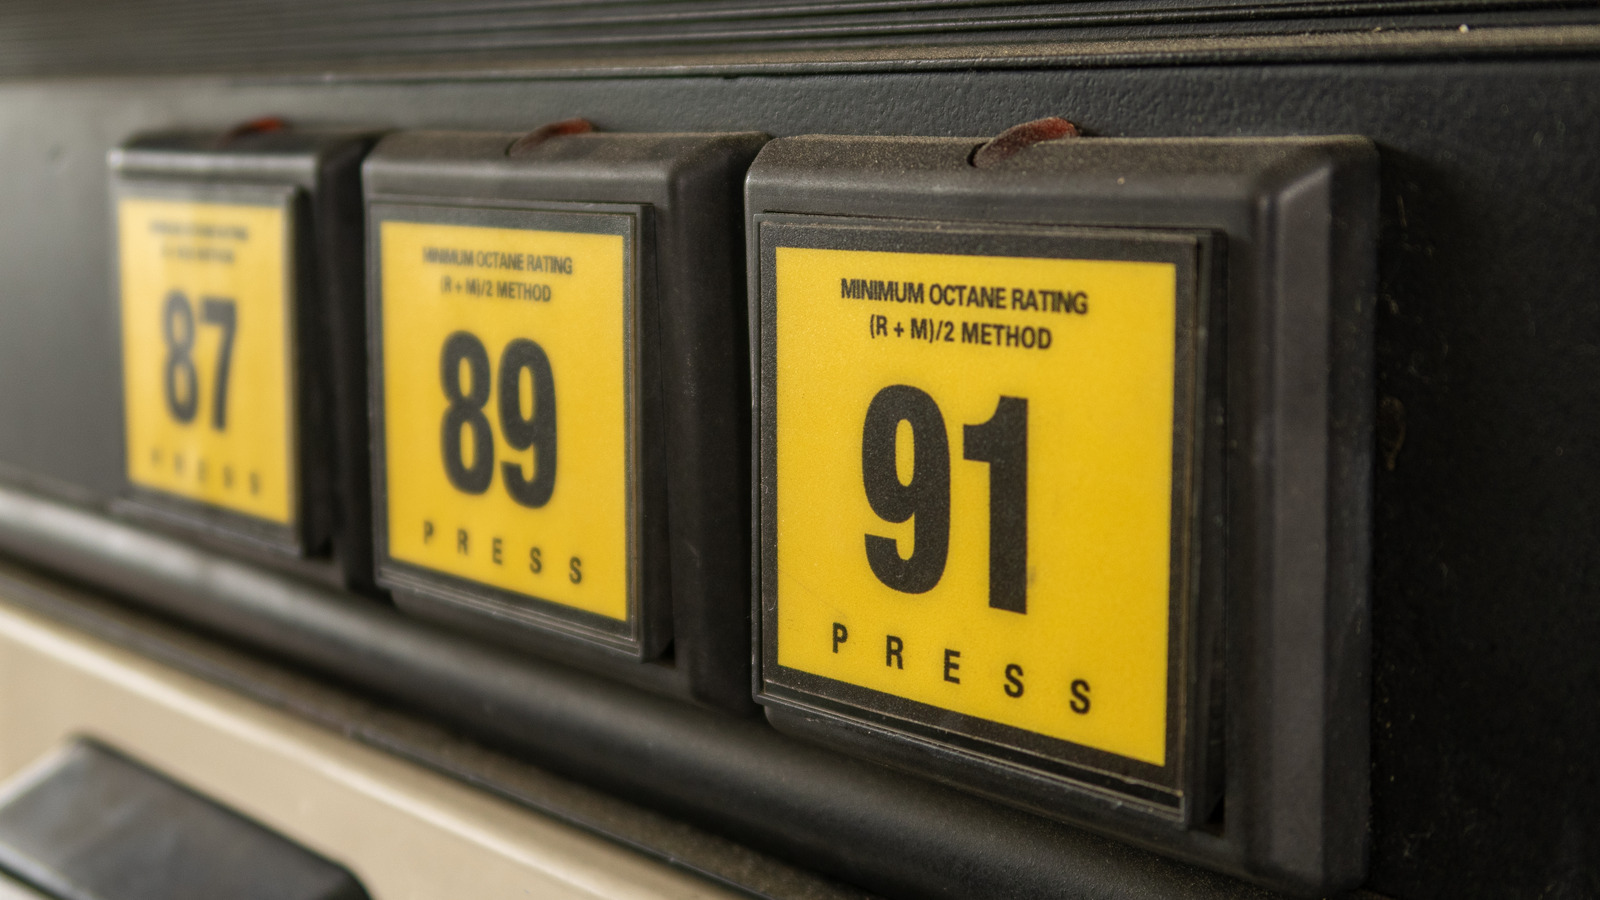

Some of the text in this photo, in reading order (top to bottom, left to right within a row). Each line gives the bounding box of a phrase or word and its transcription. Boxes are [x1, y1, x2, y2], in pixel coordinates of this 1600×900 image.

[476, 250, 524, 271] OCTANE
[527, 254, 573, 275] RATING
[496, 280, 551, 302] METHOD
[841, 278, 1088, 315] MINIMUM OCTANE RATING
[162, 288, 239, 432] 87
[869, 314, 1053, 350] (R + M)/2 METHOD
[439, 330, 557, 509] 89
[862, 384, 1029, 615] 91
[423, 520, 583, 585] PRESS
[832, 622, 1092, 715] PRESS
